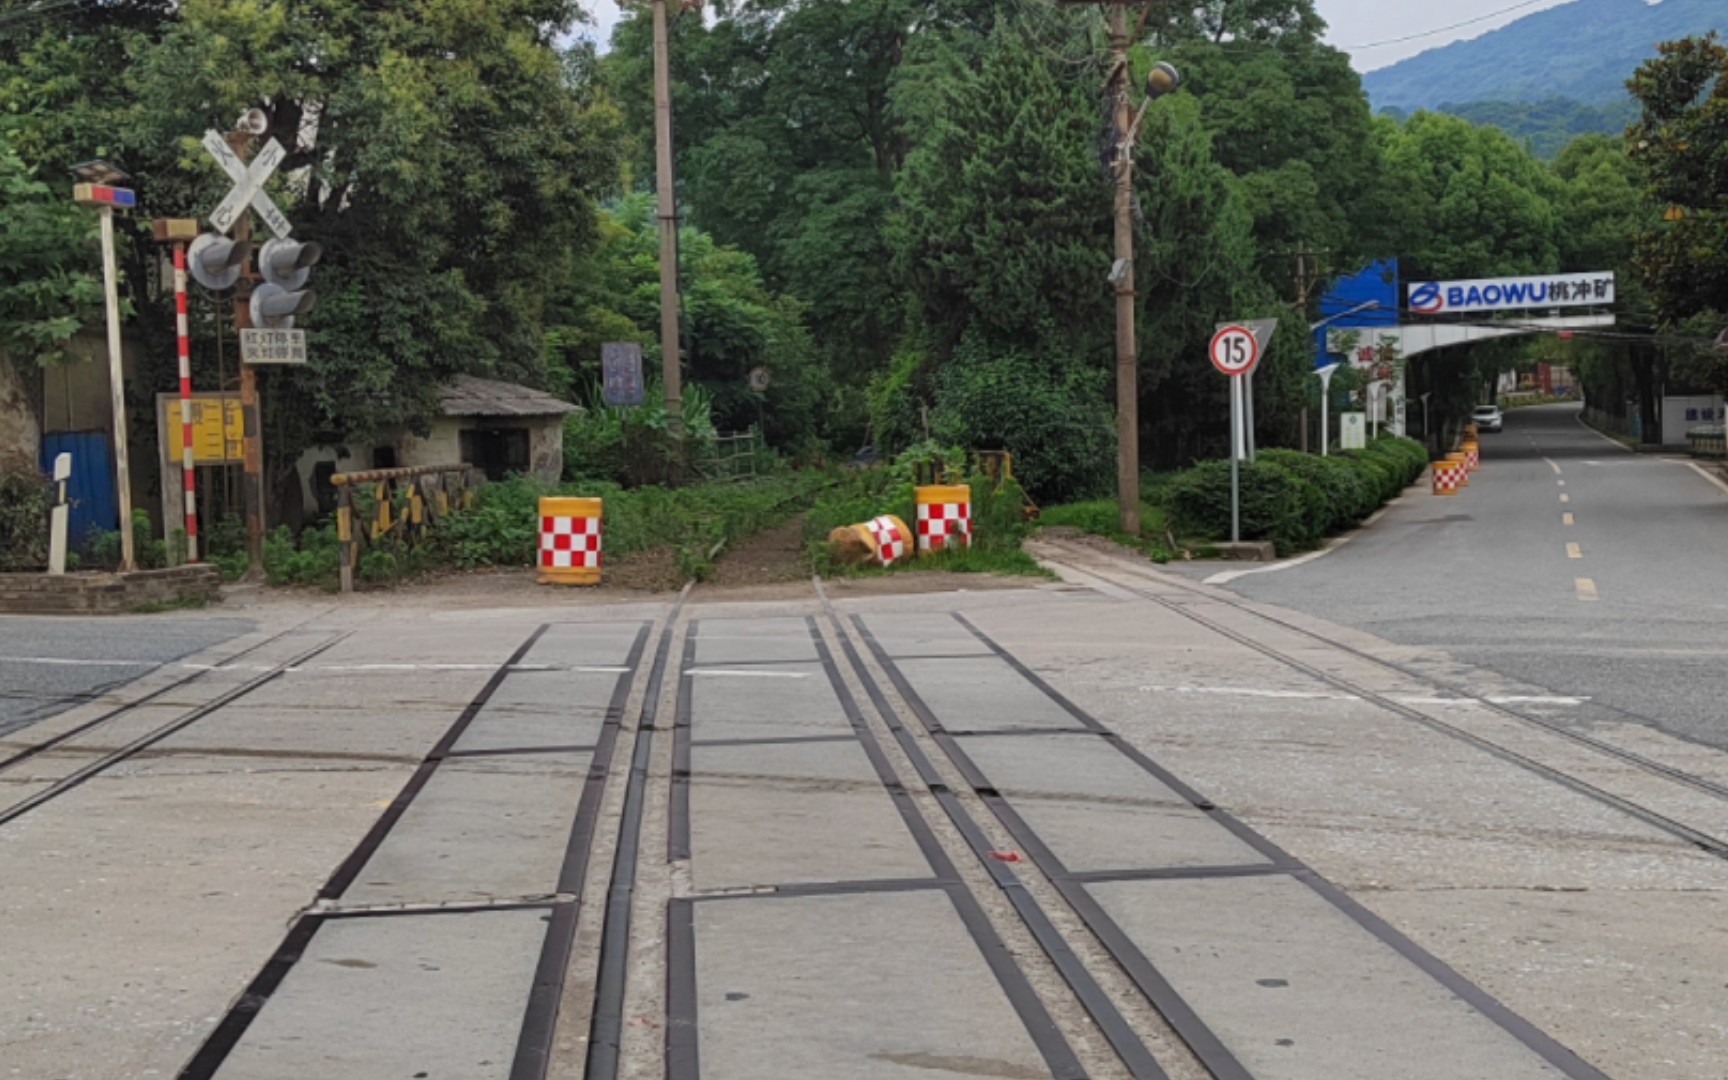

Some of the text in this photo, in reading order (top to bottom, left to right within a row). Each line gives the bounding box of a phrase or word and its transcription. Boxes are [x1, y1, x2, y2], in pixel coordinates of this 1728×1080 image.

[1447, 277, 1613, 307] BAOWU 桃冲矿
[1223, 336, 1246, 364] 15
